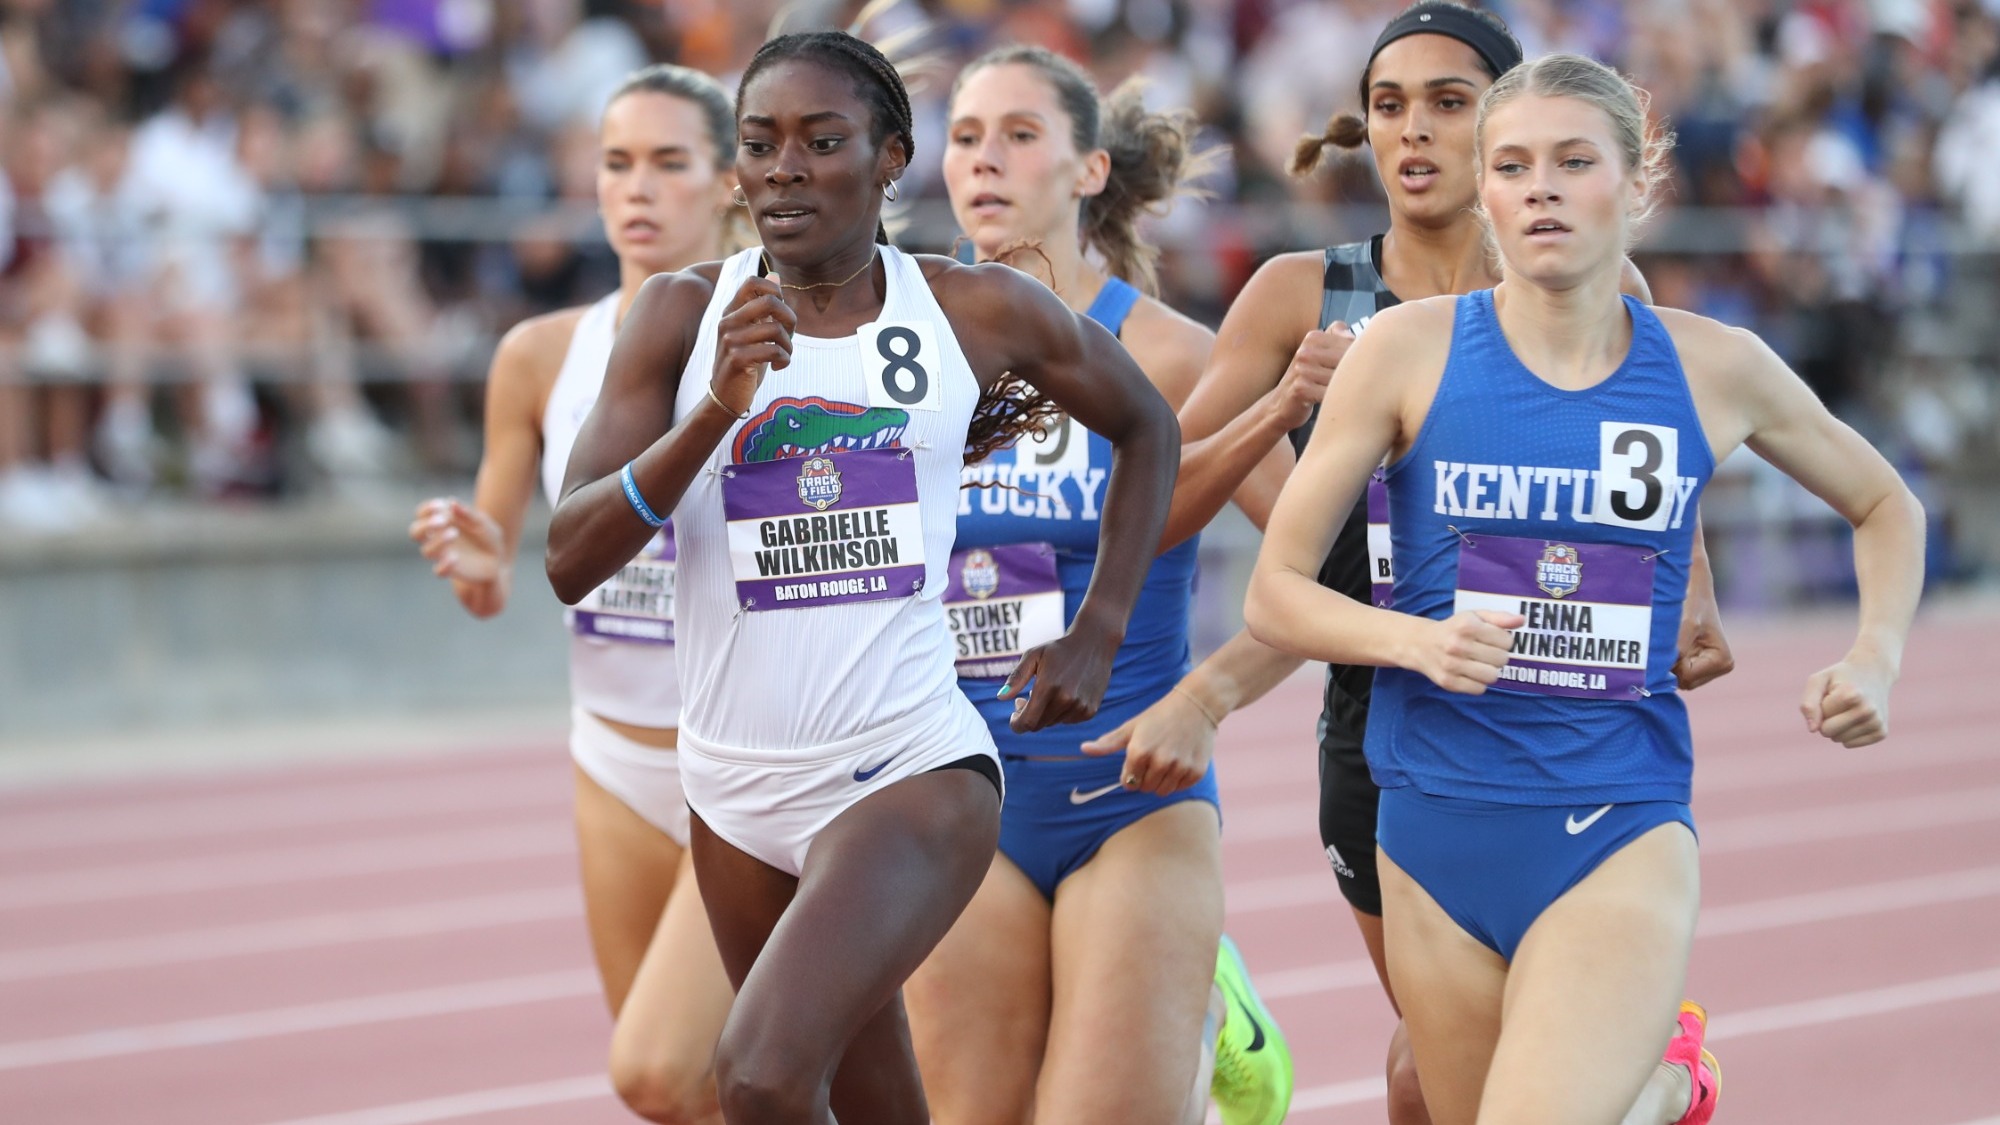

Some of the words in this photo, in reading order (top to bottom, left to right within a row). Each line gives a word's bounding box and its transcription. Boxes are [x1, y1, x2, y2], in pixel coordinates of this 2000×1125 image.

[877, 326, 928, 405] 8
[799, 475, 838, 488] TRACK
[801, 487, 808, 497] &
[810, 484, 839, 496] FIELD
[1610, 429, 1664, 521] 3
[957, 464, 1106, 521] TUCKY
[1434, 460, 1698, 529] KENTUY
[760, 509, 890, 548] GABRIELLE
[755, 537, 899, 576] WILKINSON
[1540, 562, 1579, 575] TRACK
[775, 583, 818, 601] BATON
[819, 578, 869, 596] ROUGE,
[870, 575, 888, 592] LA
[1548, 573, 1579, 584] FIELD
[949, 600, 1022, 631] SYDNEY
[956, 627, 1020, 656] STEELY
[1507, 630, 1641, 664] WINGHAMER
[1538, 669, 1588, 690] ROUGE,
[1589, 673, 1607, 690] LA
